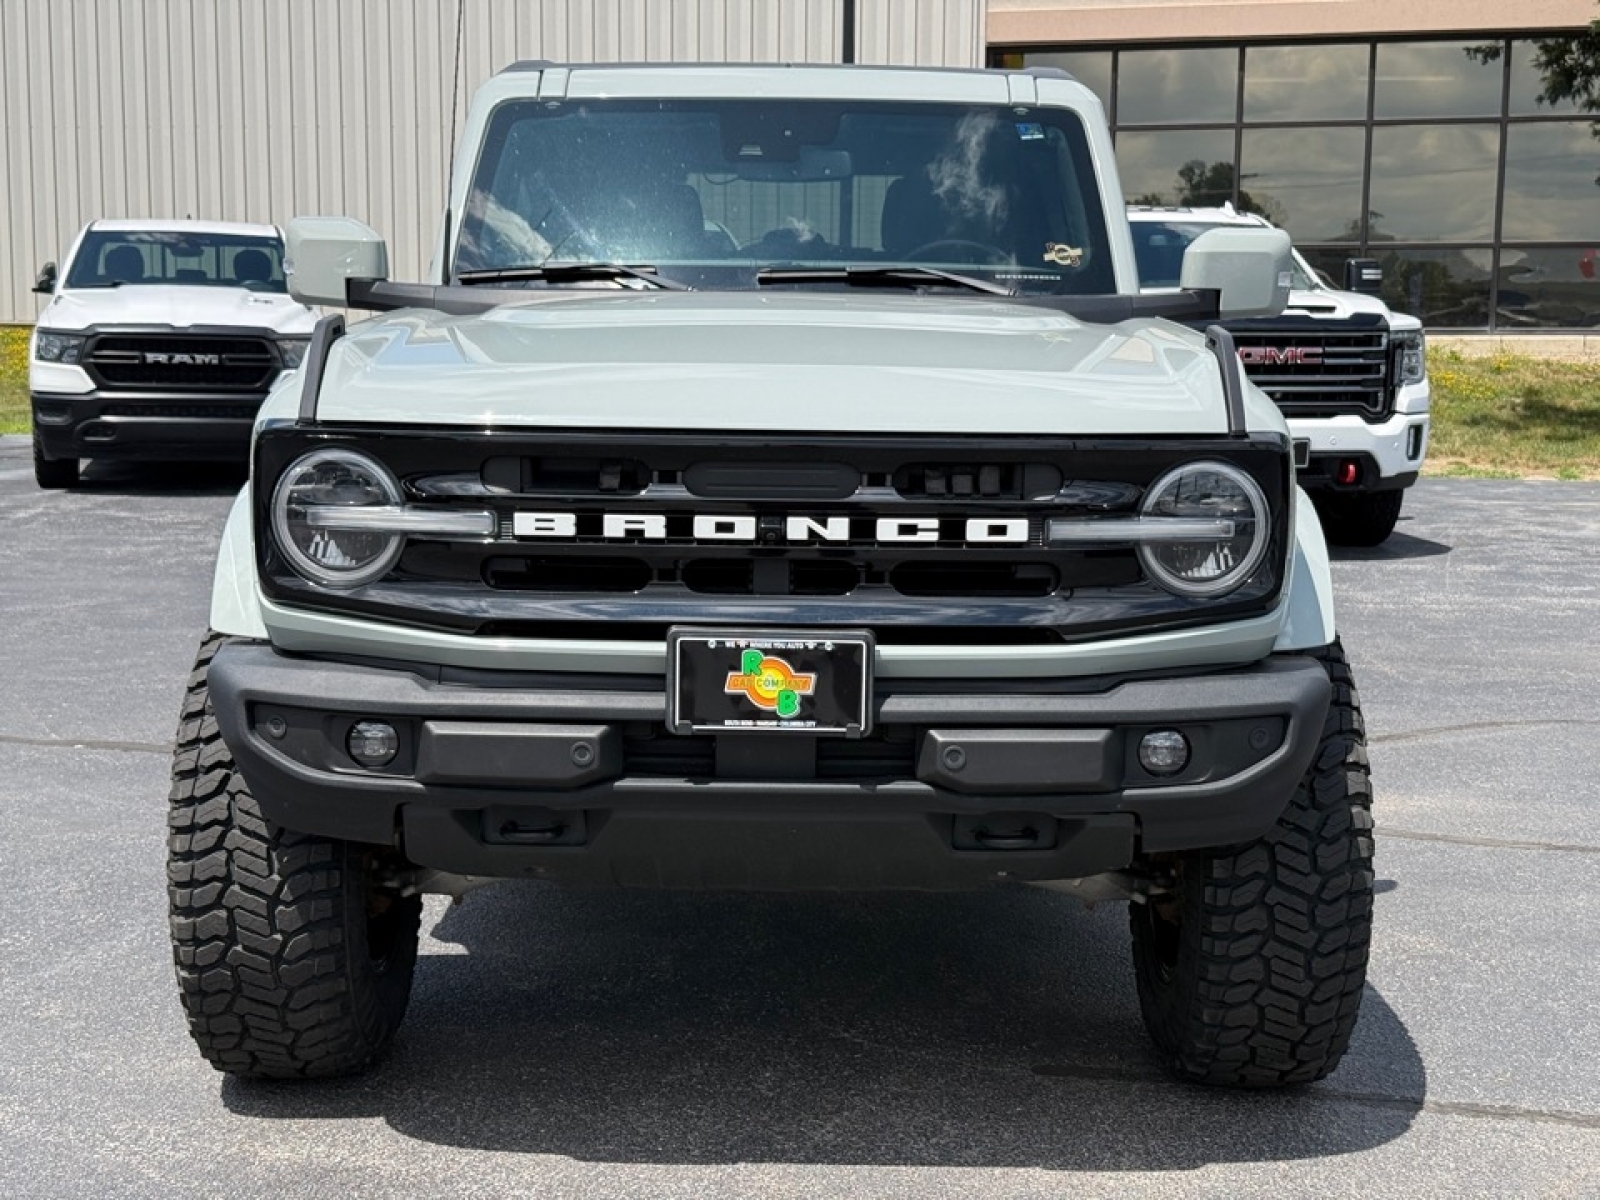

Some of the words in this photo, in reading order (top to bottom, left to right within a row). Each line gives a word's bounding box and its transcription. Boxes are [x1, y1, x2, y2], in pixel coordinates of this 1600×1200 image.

[144, 352, 219, 366] RAM
[1238, 346, 1323, 365] GMC
[513, 512, 1029, 543] BRONCO
[741, 649, 763, 676] R
[732, 676, 755, 688] CAR
[756, 676, 808, 689] COMPANY
[776, 689, 800, 718] B
